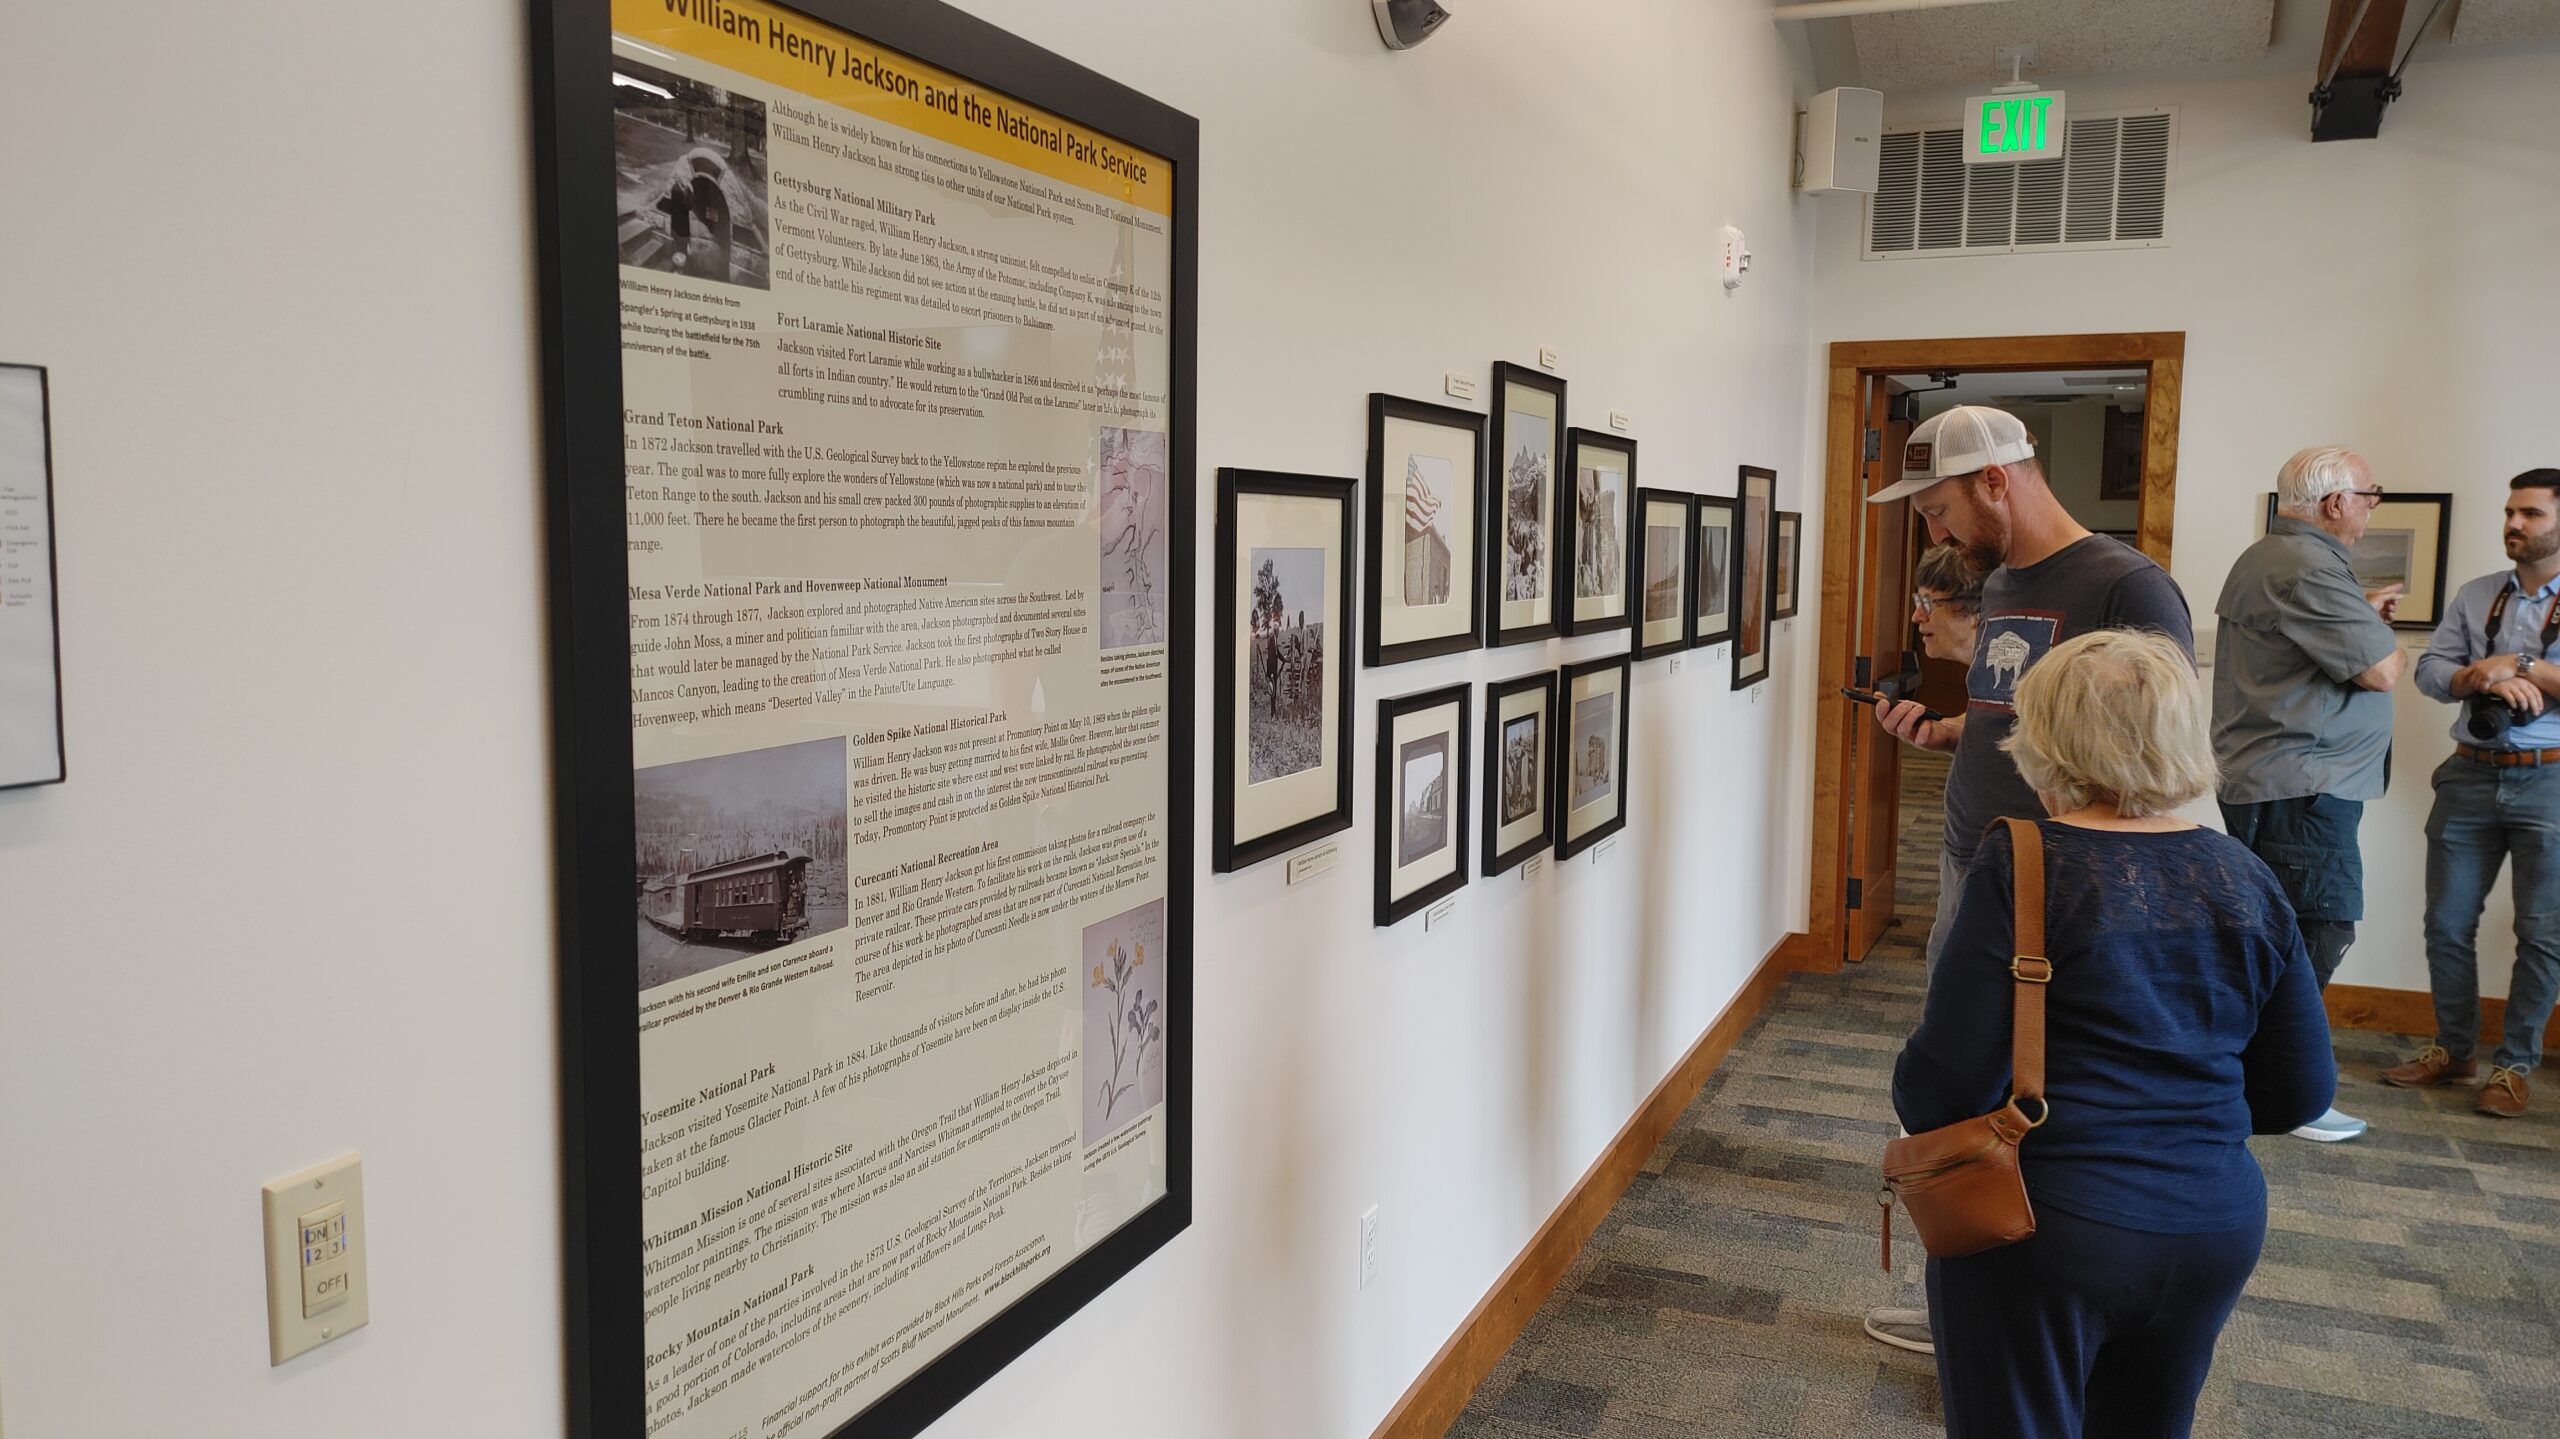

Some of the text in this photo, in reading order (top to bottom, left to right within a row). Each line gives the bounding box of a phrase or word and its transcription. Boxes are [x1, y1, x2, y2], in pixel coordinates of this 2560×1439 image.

[768, 18, 836, 78] Henry
[841, 47, 919, 102] Jackson
[924, 85, 958, 116] and
[963, 94, 992, 128] the
[997, 106, 1062, 154] National
[1066, 133, 1097, 167] Park
[1100, 146, 1147, 184] Service
[1980, 97, 2053, 154] EXIT
[773, 170, 935, 226] Gettysburg National Military Park
[650, 284, 672, 299] Henry
[673, 288, 701, 301] Jackson
[702, 293, 723, 305] drinks
[724, 296, 740, 308] from
[660, 307, 683, 322] Spring
[684, 312, 692, 321] at
[693, 312, 730, 329] Gettysburg
[731, 318, 738, 328] in
[739, 320, 755, 331] 1938
[643, 324, 670, 338] touring
[671, 328, 683, 338] the
[685, 329, 720, 343] battlefield
[721, 334, 731, 344] for
[732, 336, 744, 346] the
[745, 337, 760, 348] 75th
[665, 345, 674, 355] of
[675, 346, 687, 357] the
[688, 347, 711, 359] battle.
[777, 311, 941, 350] Fort Laramie National Historic Site
[623, 409, 783, 435] Grand Teton National Park
[629, 576, 947, 601] Mesa Verde National Park and Hovenweep National Monument
[632, 678, 955, 728] Hovenweep, which means “Deserted Valley” in the Paiute/Ute Language.
[852, 710, 1007, 747] Golden Spike National Historical Park
[854, 840, 999, 888] Curecanti National Recreation Area
[663, 1005, 694, 1026] provided
[695, 1004, 704, 1014] by
[705, 1000, 716, 1010] the
[717, 991, 741, 1006] Denver
[742, 988, 748, 997] &
[749, 985, 759, 995] Rio
[760, 977, 783, 991] Grande
[783, 969, 808, 983] Western
[809, 959, 834, 974] Railroad.
[667, 993, 684, 1005] with
[684, 989, 695, 1000] his
[696, 980, 720, 996] second
[721, 976, 735, 988] wife
[736, 970, 756, 983] Emilie
[757, 964, 769, 976] and
[770, 962, 781, 972] son
[782, 954, 807, 968] Clarence
[808, 945, 828, 959] aboard
[855, 979, 895, 1002] Reservoir.
[641, 1062, 775, 1127] Yosemite National Park
[642, 1154, 729, 1201] Capitol building.
[643, 1143, 853, 1254] Whitman Mission National Historic Site
[308, 1221, 338, 1244] ON 1
[314, 1242, 339, 1261] 2 3
[317, 1277, 342, 1294] OFF
[645, 1264, 814, 1370] Rocky Mountain National Park
[761, 1234, 1045, 1430] Financial support for this exhibit was provided by Black Hills Parks and Forests Association,
[775, 1411, 804, 1439] official
[804, 1386, 843, 1420] non-profit
[843, 1368, 871, 1396] partner
[871, 1359, 879, 1374] of
[879, 1347, 900, 1368] Scotts
[901, 1333, 918, 1354] Bluff
[917, 1315, 945, 1342] National
[945, 1293, 978, 1323] Monument.
[984, 1245, 1051, 1296] www.blackhillsparks.org
